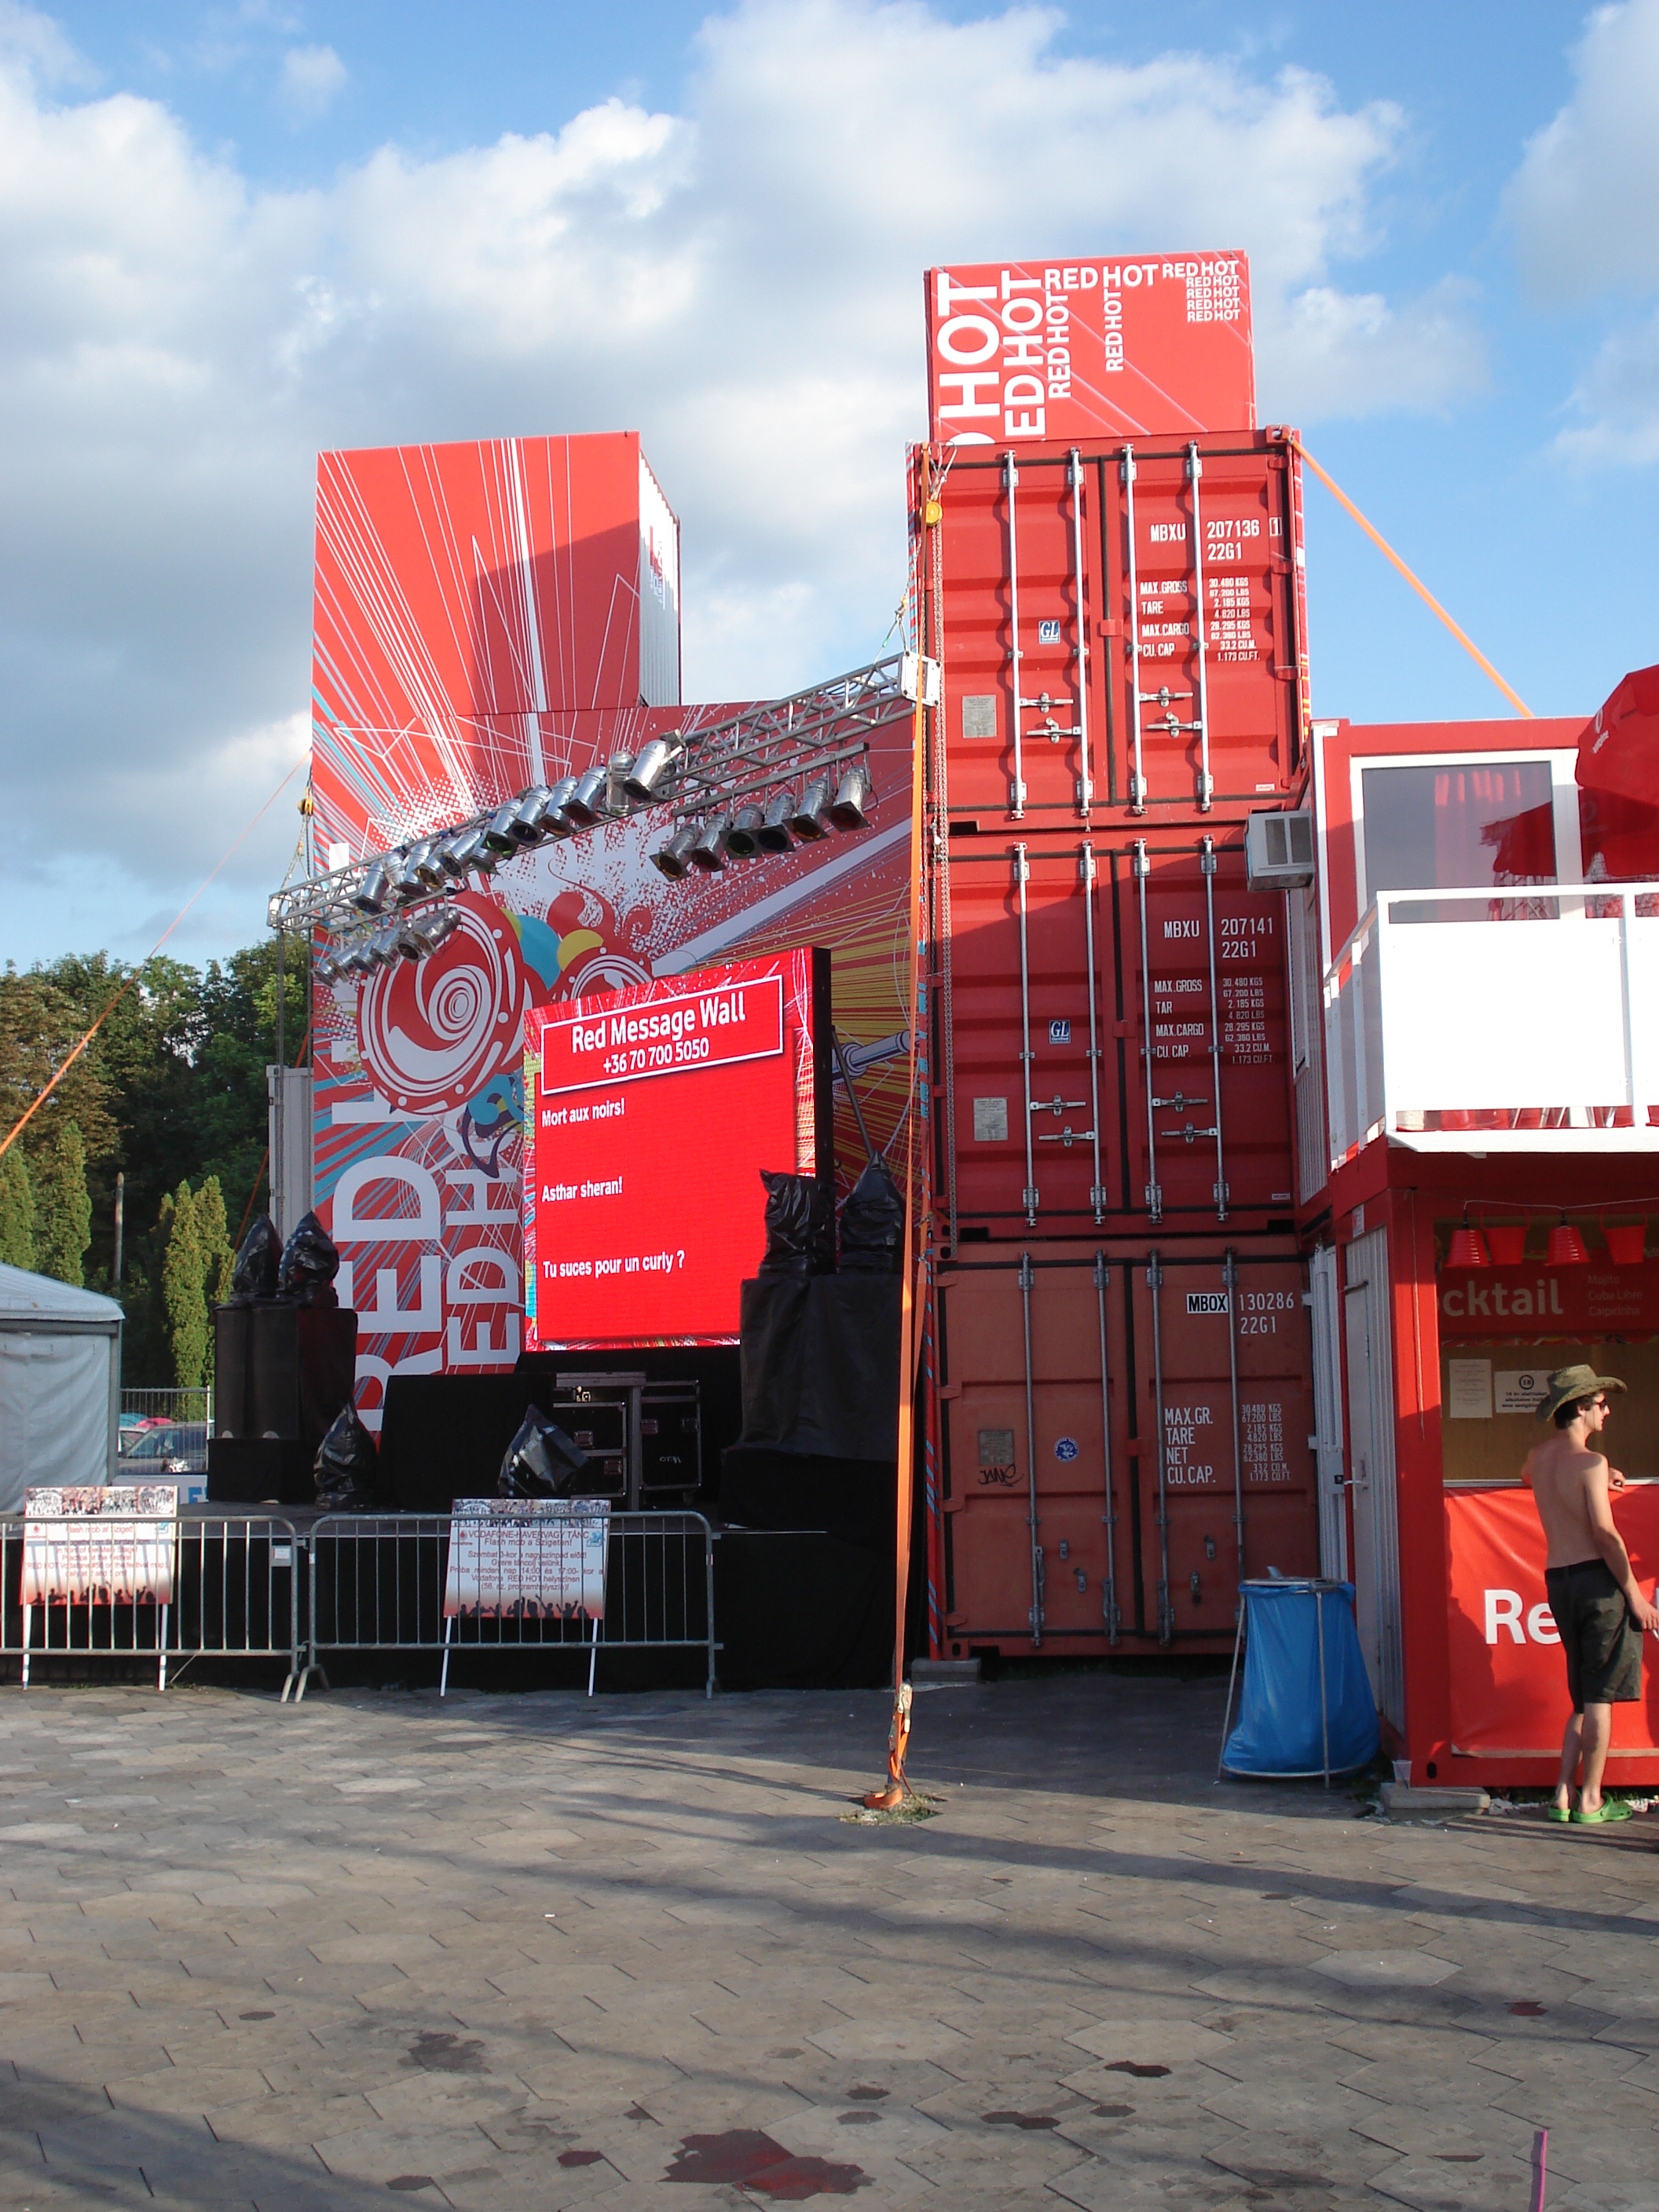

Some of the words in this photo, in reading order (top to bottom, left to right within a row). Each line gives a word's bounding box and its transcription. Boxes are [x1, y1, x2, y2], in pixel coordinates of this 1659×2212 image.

[1045, 266, 1098, 291] RED
[1103, 264, 1159, 287] HOT
[1163, 262, 1198, 278] RED
[1202, 260, 1239, 276] HOT
[1186, 276, 1211, 287] RED
[1214, 275, 1239, 286] HOT
[1187, 287, 1212, 298] RED
[1214, 286, 1240, 297] HOT
[1104, 288, 1122, 329] HOT
[1187, 299, 1212, 310] RED
[1214, 298, 1240, 309] HOT
[1001, 270, 1043, 366] HOT
[1046, 290, 1069, 343] HOT
[1188, 310, 1213, 322] RED
[1214, 309, 1240, 320] HOT
[937, 273, 1000, 418] HOT
[1105, 331, 1123, 372] RED
[1048, 346, 1071, 398] RED
[1004, 374, 1046, 438] ED
[1151, 523, 1186, 542] MBXU
[1207, 519, 1260, 538] 207136
[1207, 542, 1242, 561] 22G1
[1140, 580, 1188, 595] MAX.GROSS
[1209, 577, 1234, 588] 30.480
[1236, 577, 1249, 586] KGS
[1141, 601, 1164, 615] TARE
[1214, 598, 1235, 607] 2.185
[1236, 597, 1250, 606] KGS
[1236, 609, 1250, 617] LBS
[1041, 621, 1058, 637] GL
[1141, 622, 1189, 637] MAX.CARGO
[1237, 620, 1251, 629] KGS
[1221, 640, 1236, 650] 33.2
[1218, 652, 1237, 661] 1.173
[1164, 920, 1199, 939] MBXU
[1221, 917, 1273, 936] 207141
[1222, 940, 1256, 958] 22G1
[1154, 979, 1203, 993] MAX.GROSS
[1223, 978, 1247, 987] 30.480
[1250, 977, 1262, 986] KGS
[1155, 1002, 1172, 1014] TAR
[1228, 999, 1249, 1009] 2.185
[1251, 998, 1264, 1008] KGS
[1251, 1010, 1265, 1019] LBS
[572, 1024, 606, 1054] Red
[610, 1011, 695, 1046] Message
[699, 991, 746, 1027] Wall
[1051, 1021, 1068, 1037] GL
[1155, 1023, 1204, 1037] MAX.CARGO
[1251, 1022, 1265, 1031] KGS
[602, 1053, 628, 1075] +36
[629, 1049, 646, 1069] 70
[648, 1046, 672, 1067] 700
[675, 1036, 709, 1063] 5050
[1234, 1044, 1251, 1053] 33.2
[1232, 1055, 1251, 1064] 1.173
[541, 1106, 567, 1128] Mort
[569, 1104, 589, 1123] aux
[591, 1097, 625, 1119] noirs!
[541, 1183, 577, 1203] Asthar
[580, 1176, 624, 1198] sheran!
[543, 1260, 557, 1279] Tu
[559, 1257, 592, 1277] suces
[595, 1257, 623, 1279] pour
[624, 1256, 639, 1273] un
[642, 1250, 674, 1274] curly
[676, 1249, 685, 1269] ?
[1588, 1275, 1620, 1286] Mojito
[331, 1155, 443, 1432] RED
[1188, 1295, 1227, 1312] MBOX
[1239, 1292, 1294, 1311] 130286
[1437, 1279, 1563, 1317] cktail
[1588, 1291, 1615, 1300] Cuba
[1617, 1291, 1643, 1300] Libre
[446, 1246, 520, 1366] ED
[1590, 1306, 1640, 1318] Caipirinha
[1240, 1317, 1276, 1335] 22G1
[1164, 1407, 1213, 1426] MAX.GR.
[1269, 1404, 1281, 1413] KGS
[1166, 1426, 1196, 1445] TARE
[1269, 1423, 1282, 1432] KGS
[1166, 1447, 1188, 1464] NET
[1270, 1444, 1283, 1452] KGS
[1271, 1452, 1283, 1461] LBS
[1485, 1589, 1562, 1645] Re
